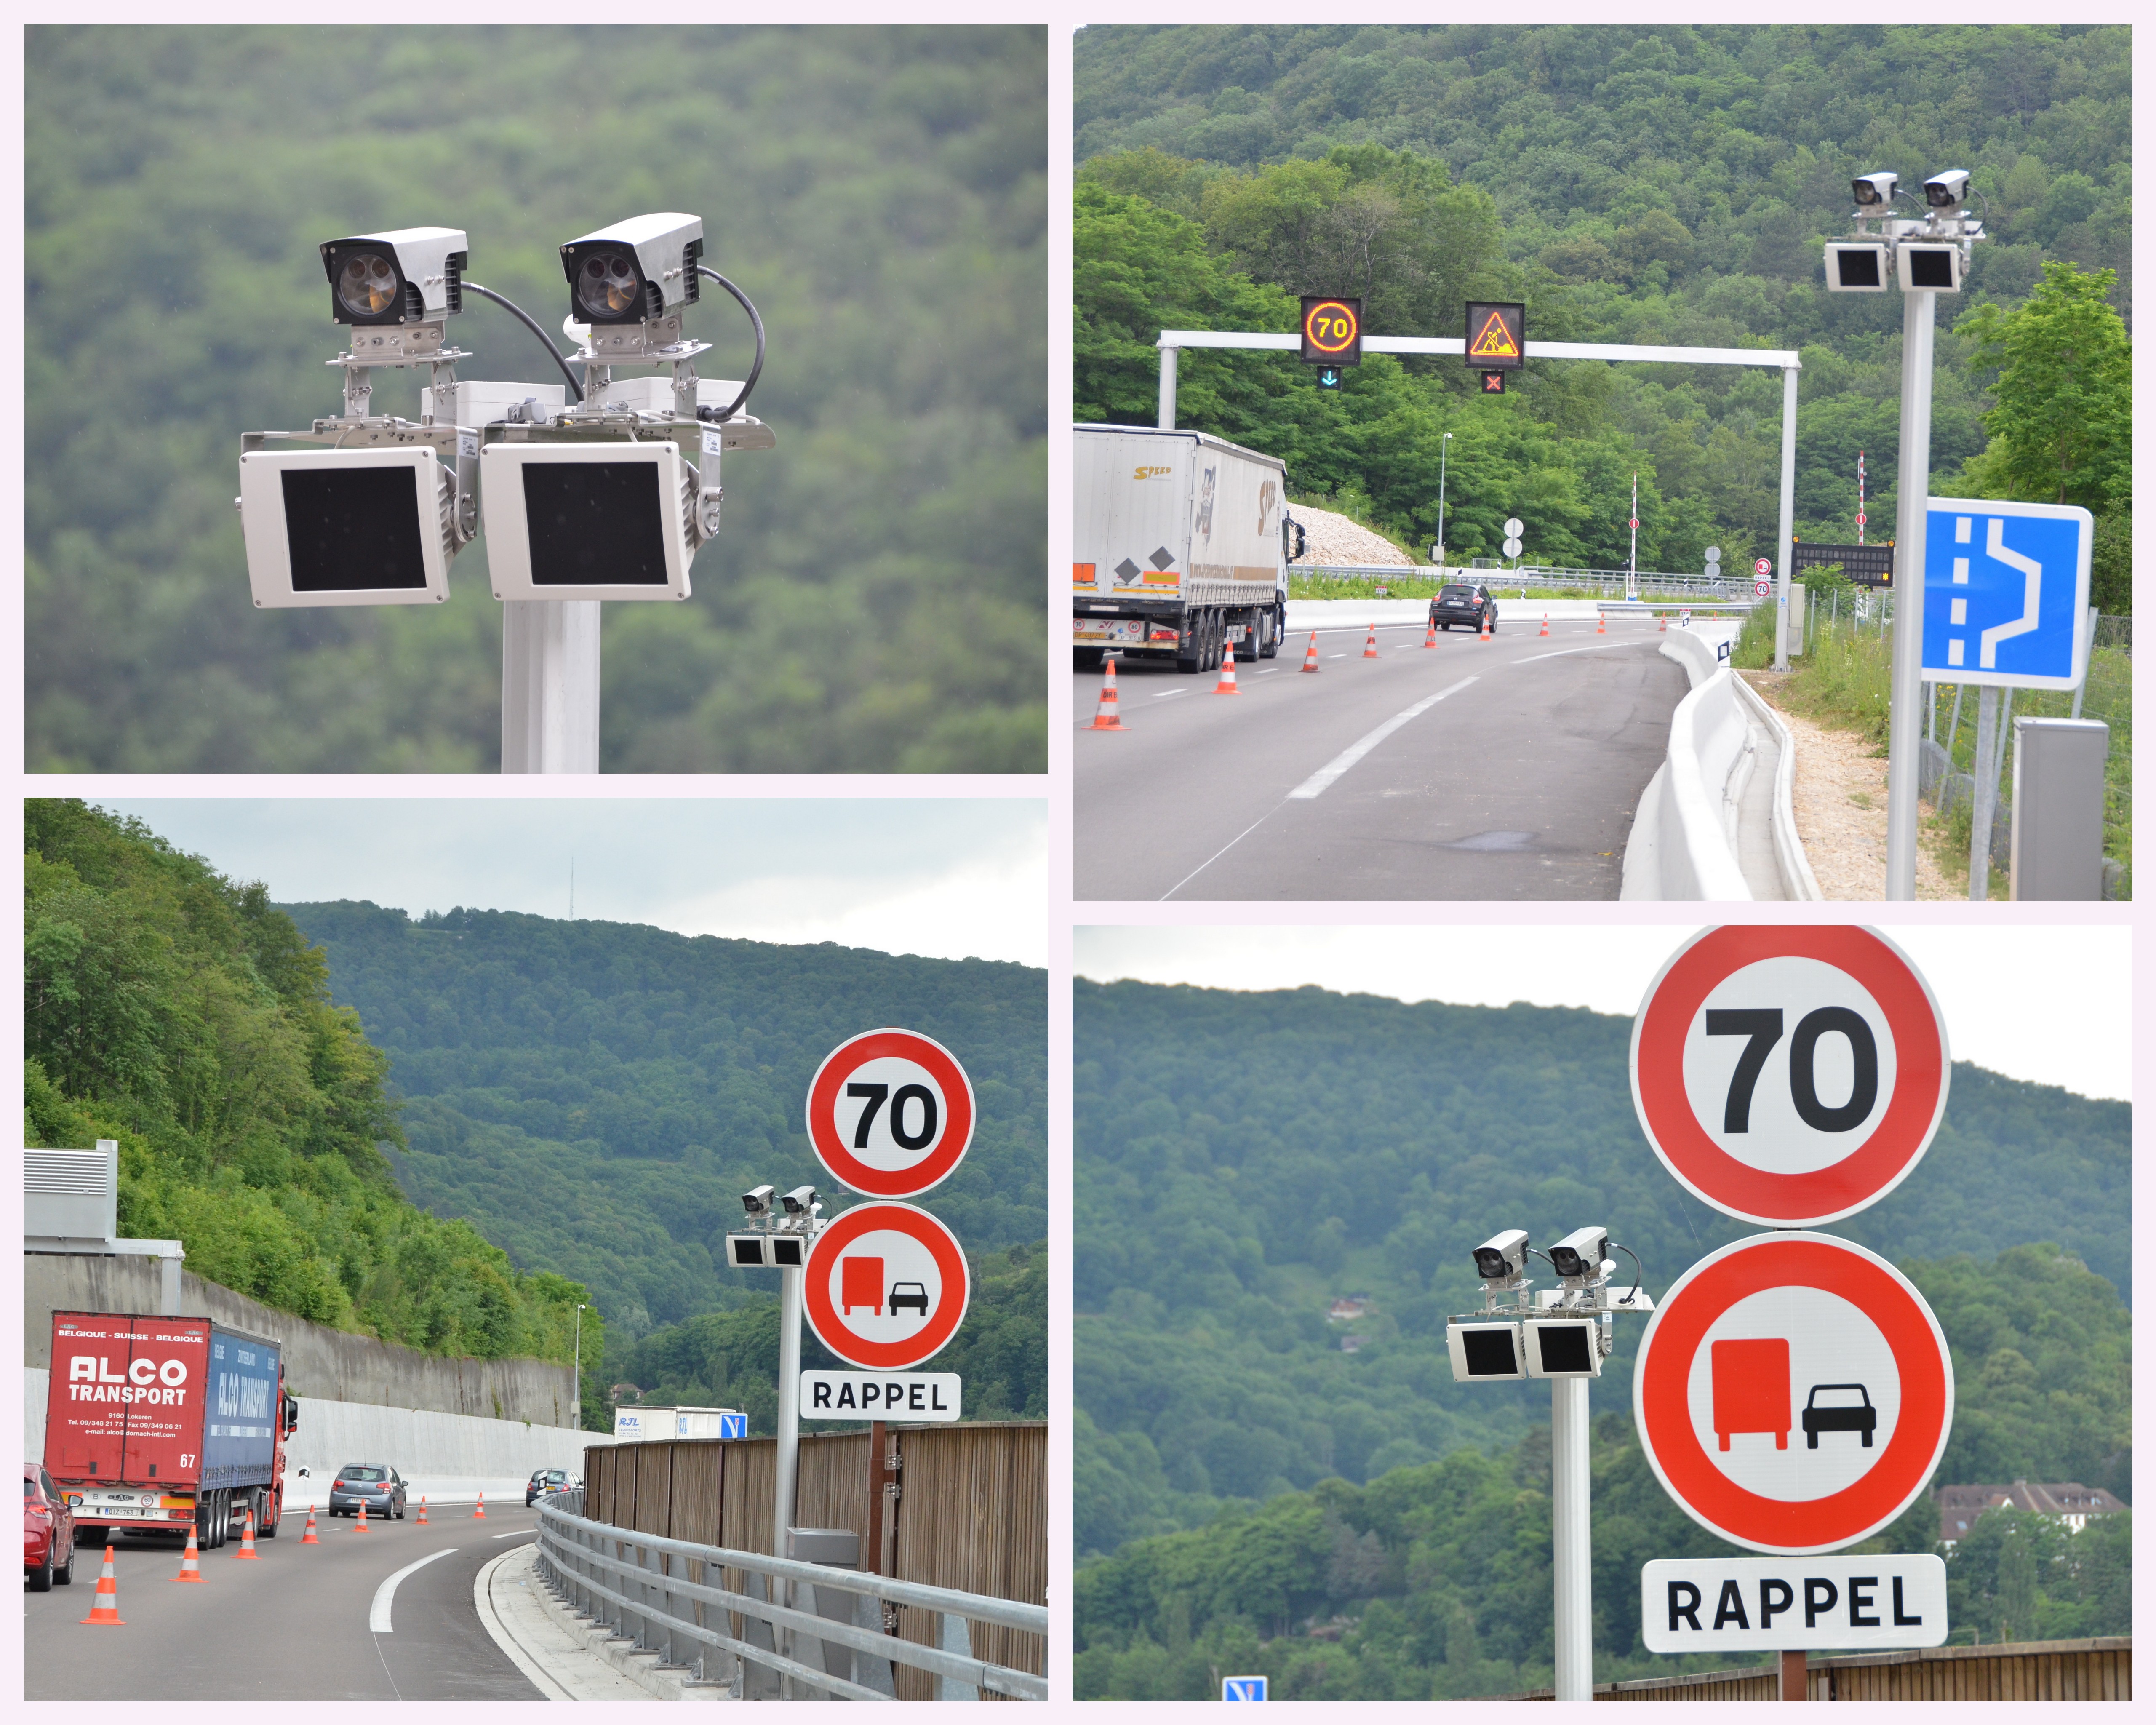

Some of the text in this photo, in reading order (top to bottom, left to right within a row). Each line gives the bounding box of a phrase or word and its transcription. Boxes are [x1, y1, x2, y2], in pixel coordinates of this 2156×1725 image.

[1318, 318, 1348, 338] 70
[1133, 466, 1171, 480] SPEED
[1706, 1005, 1879, 1134] 70
[847, 1083, 937, 1151] 70
[58, 1330, 107, 1338] BELGIQUE
[156, 1335, 203, 1343] BELGIQUE
[69, 1356, 187, 1386] ALCO
[69, 1385, 186, 1405] TRANSPORT
[218, 1372, 269, 1418] ALCO TRANSPORT
[814, 1381, 947, 1411] RAPPEL
[619, 1417, 640, 1426] RJL
[180, 1454, 195, 1468] 67
[1667, 1576, 1923, 1632] RAPPEL
